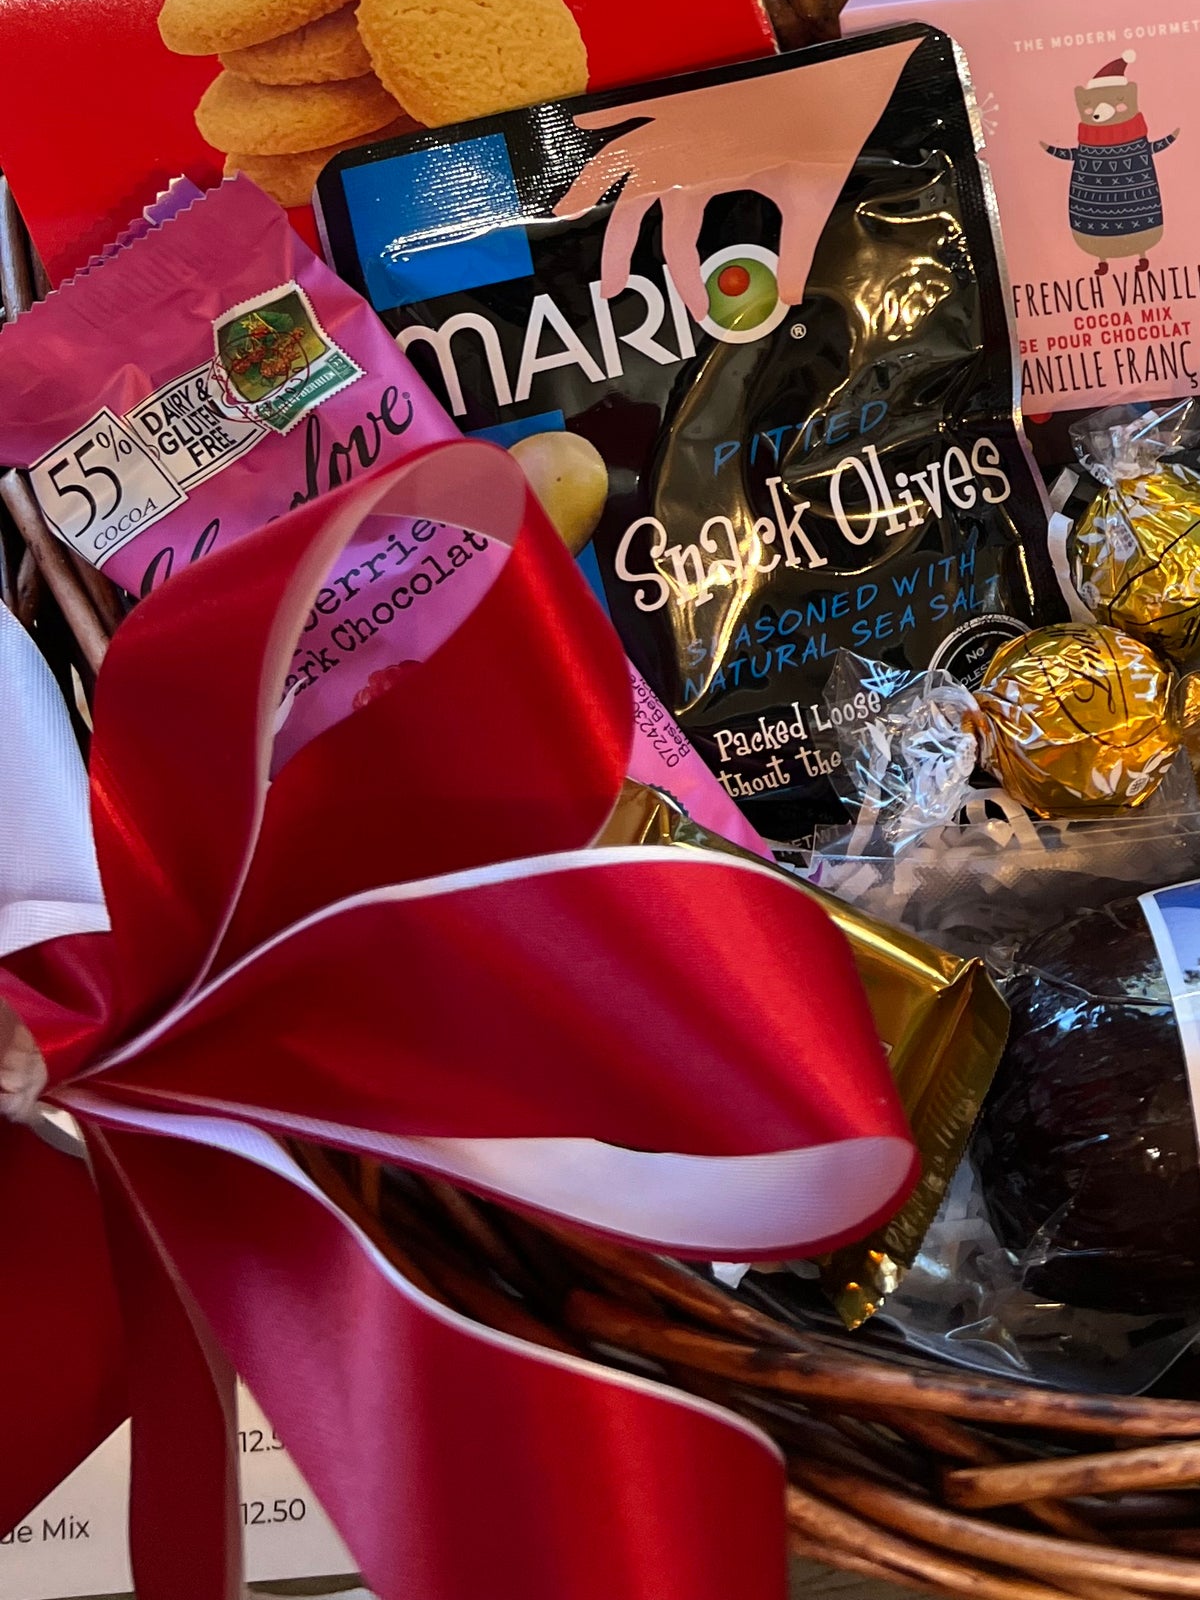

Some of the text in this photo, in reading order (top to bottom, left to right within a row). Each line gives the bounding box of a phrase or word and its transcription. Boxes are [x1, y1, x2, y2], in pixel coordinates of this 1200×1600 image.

[1014, 38, 1044, 53] THE
[1051, 29, 1117, 49] MODERN
[1012, 275, 1102, 319] FRENCH
[1073, 306, 1173, 332] COCOA MIX
[393, 243, 789, 418] MARIO
[1047, 334, 1093, 351] POUR
[1100, 321, 1192, 347] CHOCOLAT
[140, 377, 213, 436] DAIRY &
[157, 400, 227, 457] GLUTEN
[191, 426, 237, 468] FREE
[713, 400, 888, 478] PITTED
[48, 426, 133, 538] 55%
[93, 497, 159, 551] COCOA
[615, 436, 1011, 613] Snack Olives
[893, 550, 976, 597] WITH
[851, 573, 1000, 648] SEA SALT
[713, 690, 882, 763] Packed Loose
[797, 745, 842, 778] the
[42, 1515, 90, 1542] Mix
[239, 1497, 306, 1526] 12.50
